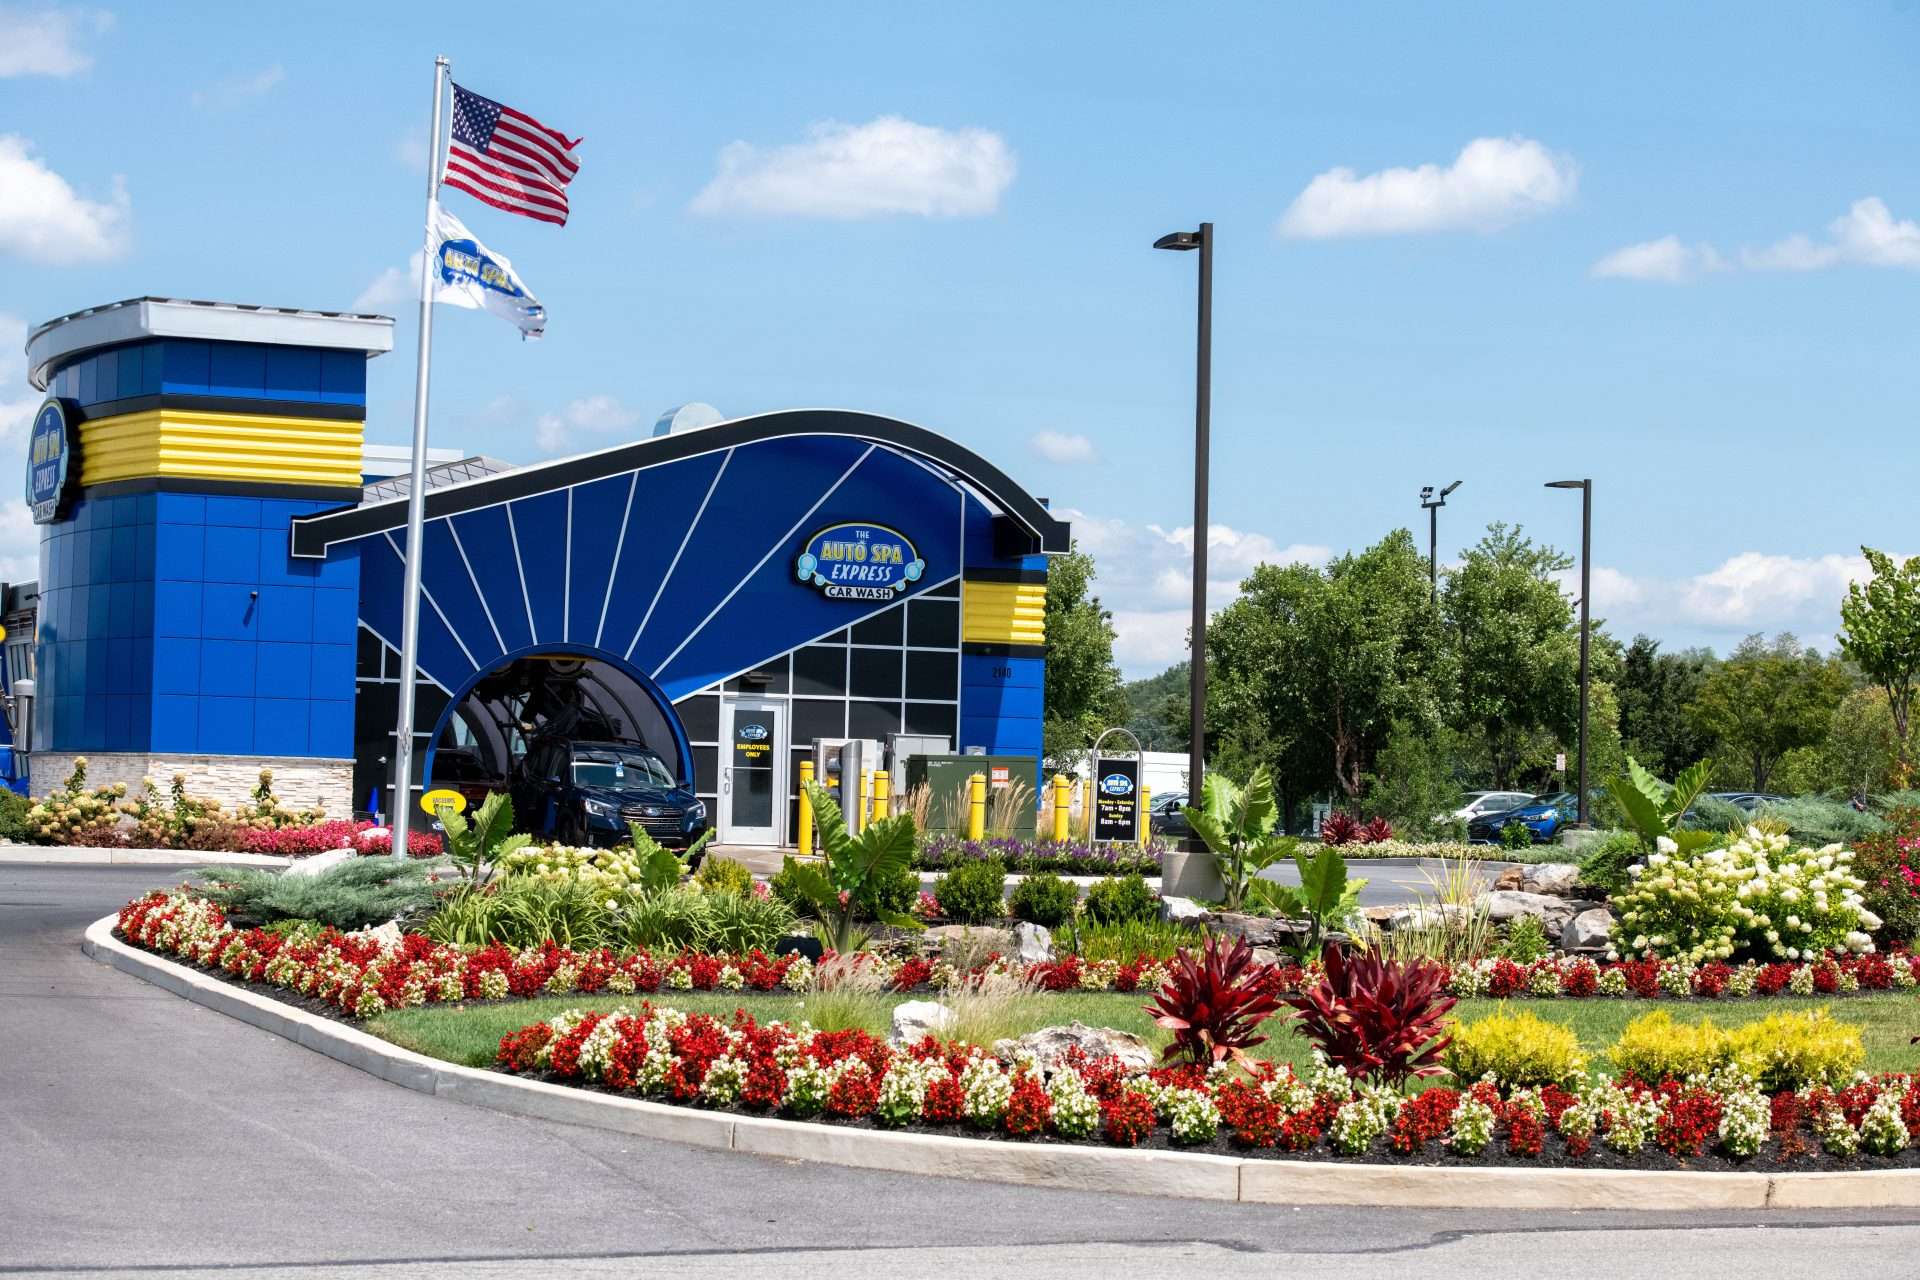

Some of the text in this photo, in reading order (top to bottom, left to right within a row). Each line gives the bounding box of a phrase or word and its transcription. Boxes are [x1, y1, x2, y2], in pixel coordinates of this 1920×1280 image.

[855, 530, 870, 539] THE
[820, 540, 903, 565] AUTO SPA
[831, 564, 893, 582] EXPRESS
[828, 586, 891, 600] CAR WASH
[736, 743, 770, 751] EMPLOYEES
